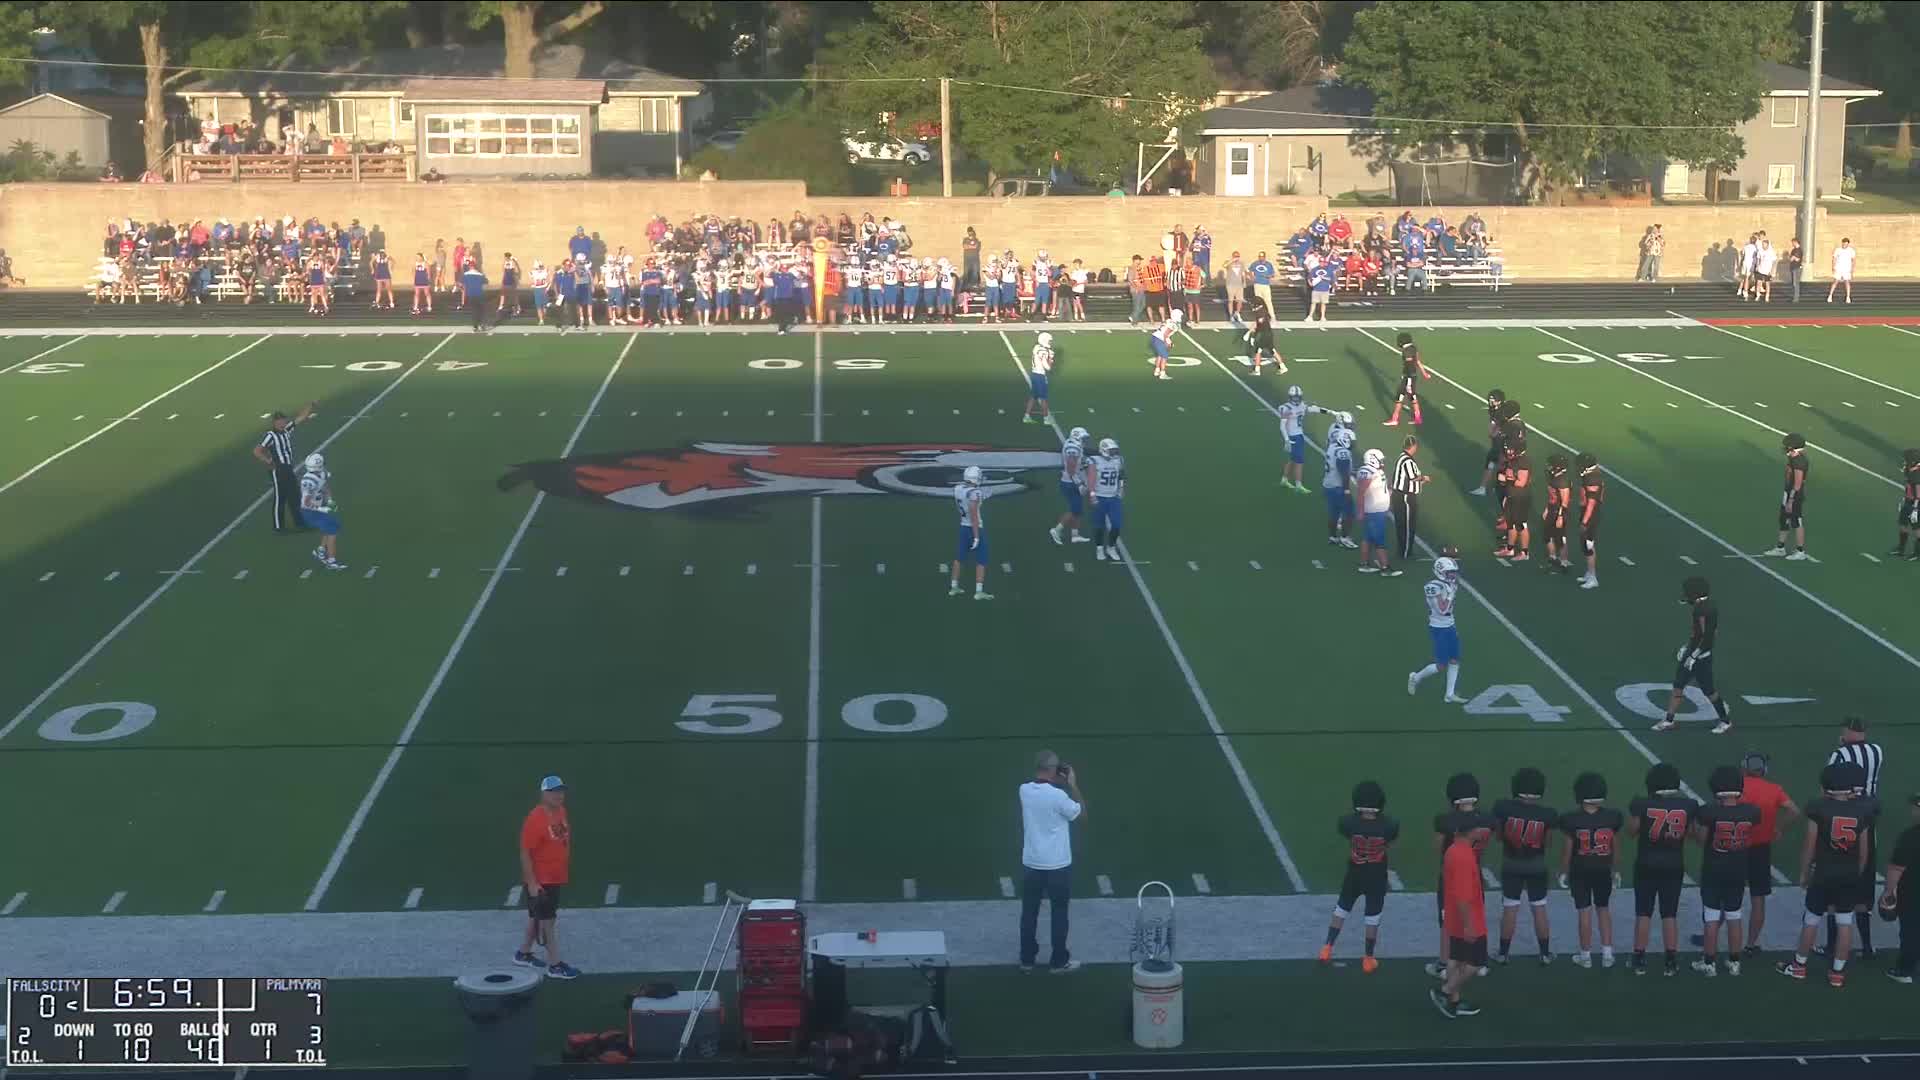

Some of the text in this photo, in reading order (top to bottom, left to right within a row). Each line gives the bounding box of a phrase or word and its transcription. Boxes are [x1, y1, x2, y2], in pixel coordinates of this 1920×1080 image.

[1100, 470, 1118, 487] 58
[1506, 816, 1545, 849] 44
[1831, 816, 1858, 849] 5
